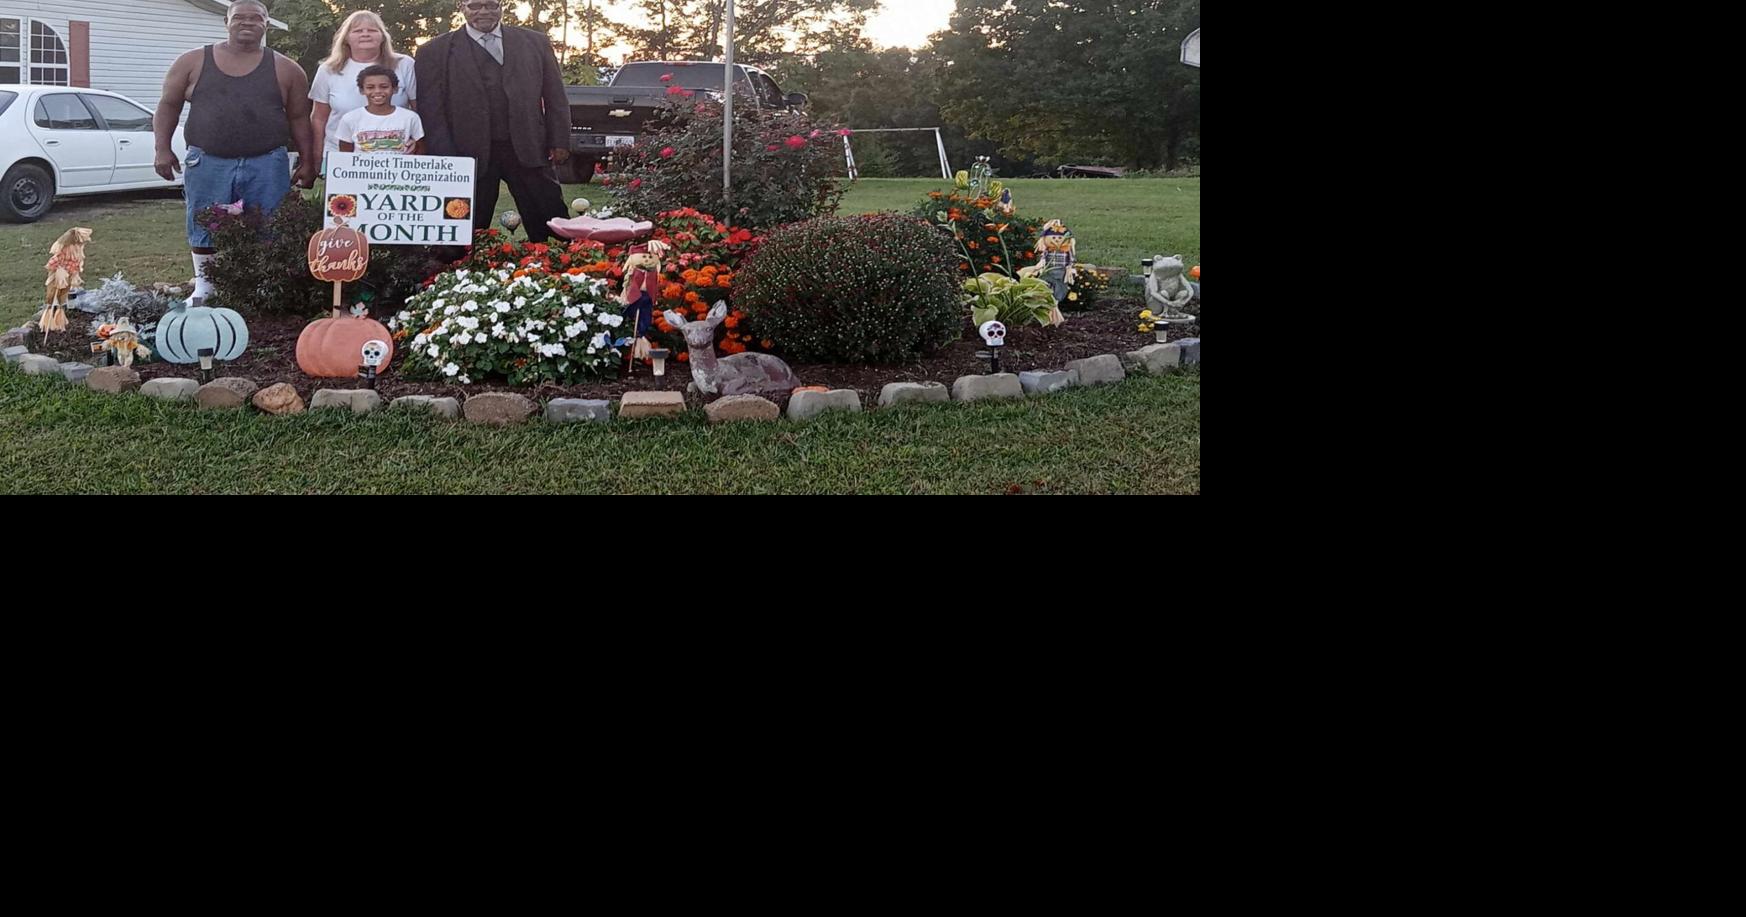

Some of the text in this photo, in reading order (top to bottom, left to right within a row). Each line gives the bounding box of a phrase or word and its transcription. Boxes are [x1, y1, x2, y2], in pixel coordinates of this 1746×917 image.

[352, 156, 453, 171] Project Timberlake
[332, 167, 470, 184] Community Organization
[360, 193, 442, 212] YARD
[377, 212, 424, 222] OF THE
[319, 237, 354, 256] give
[309, 249, 368, 273] thanks
